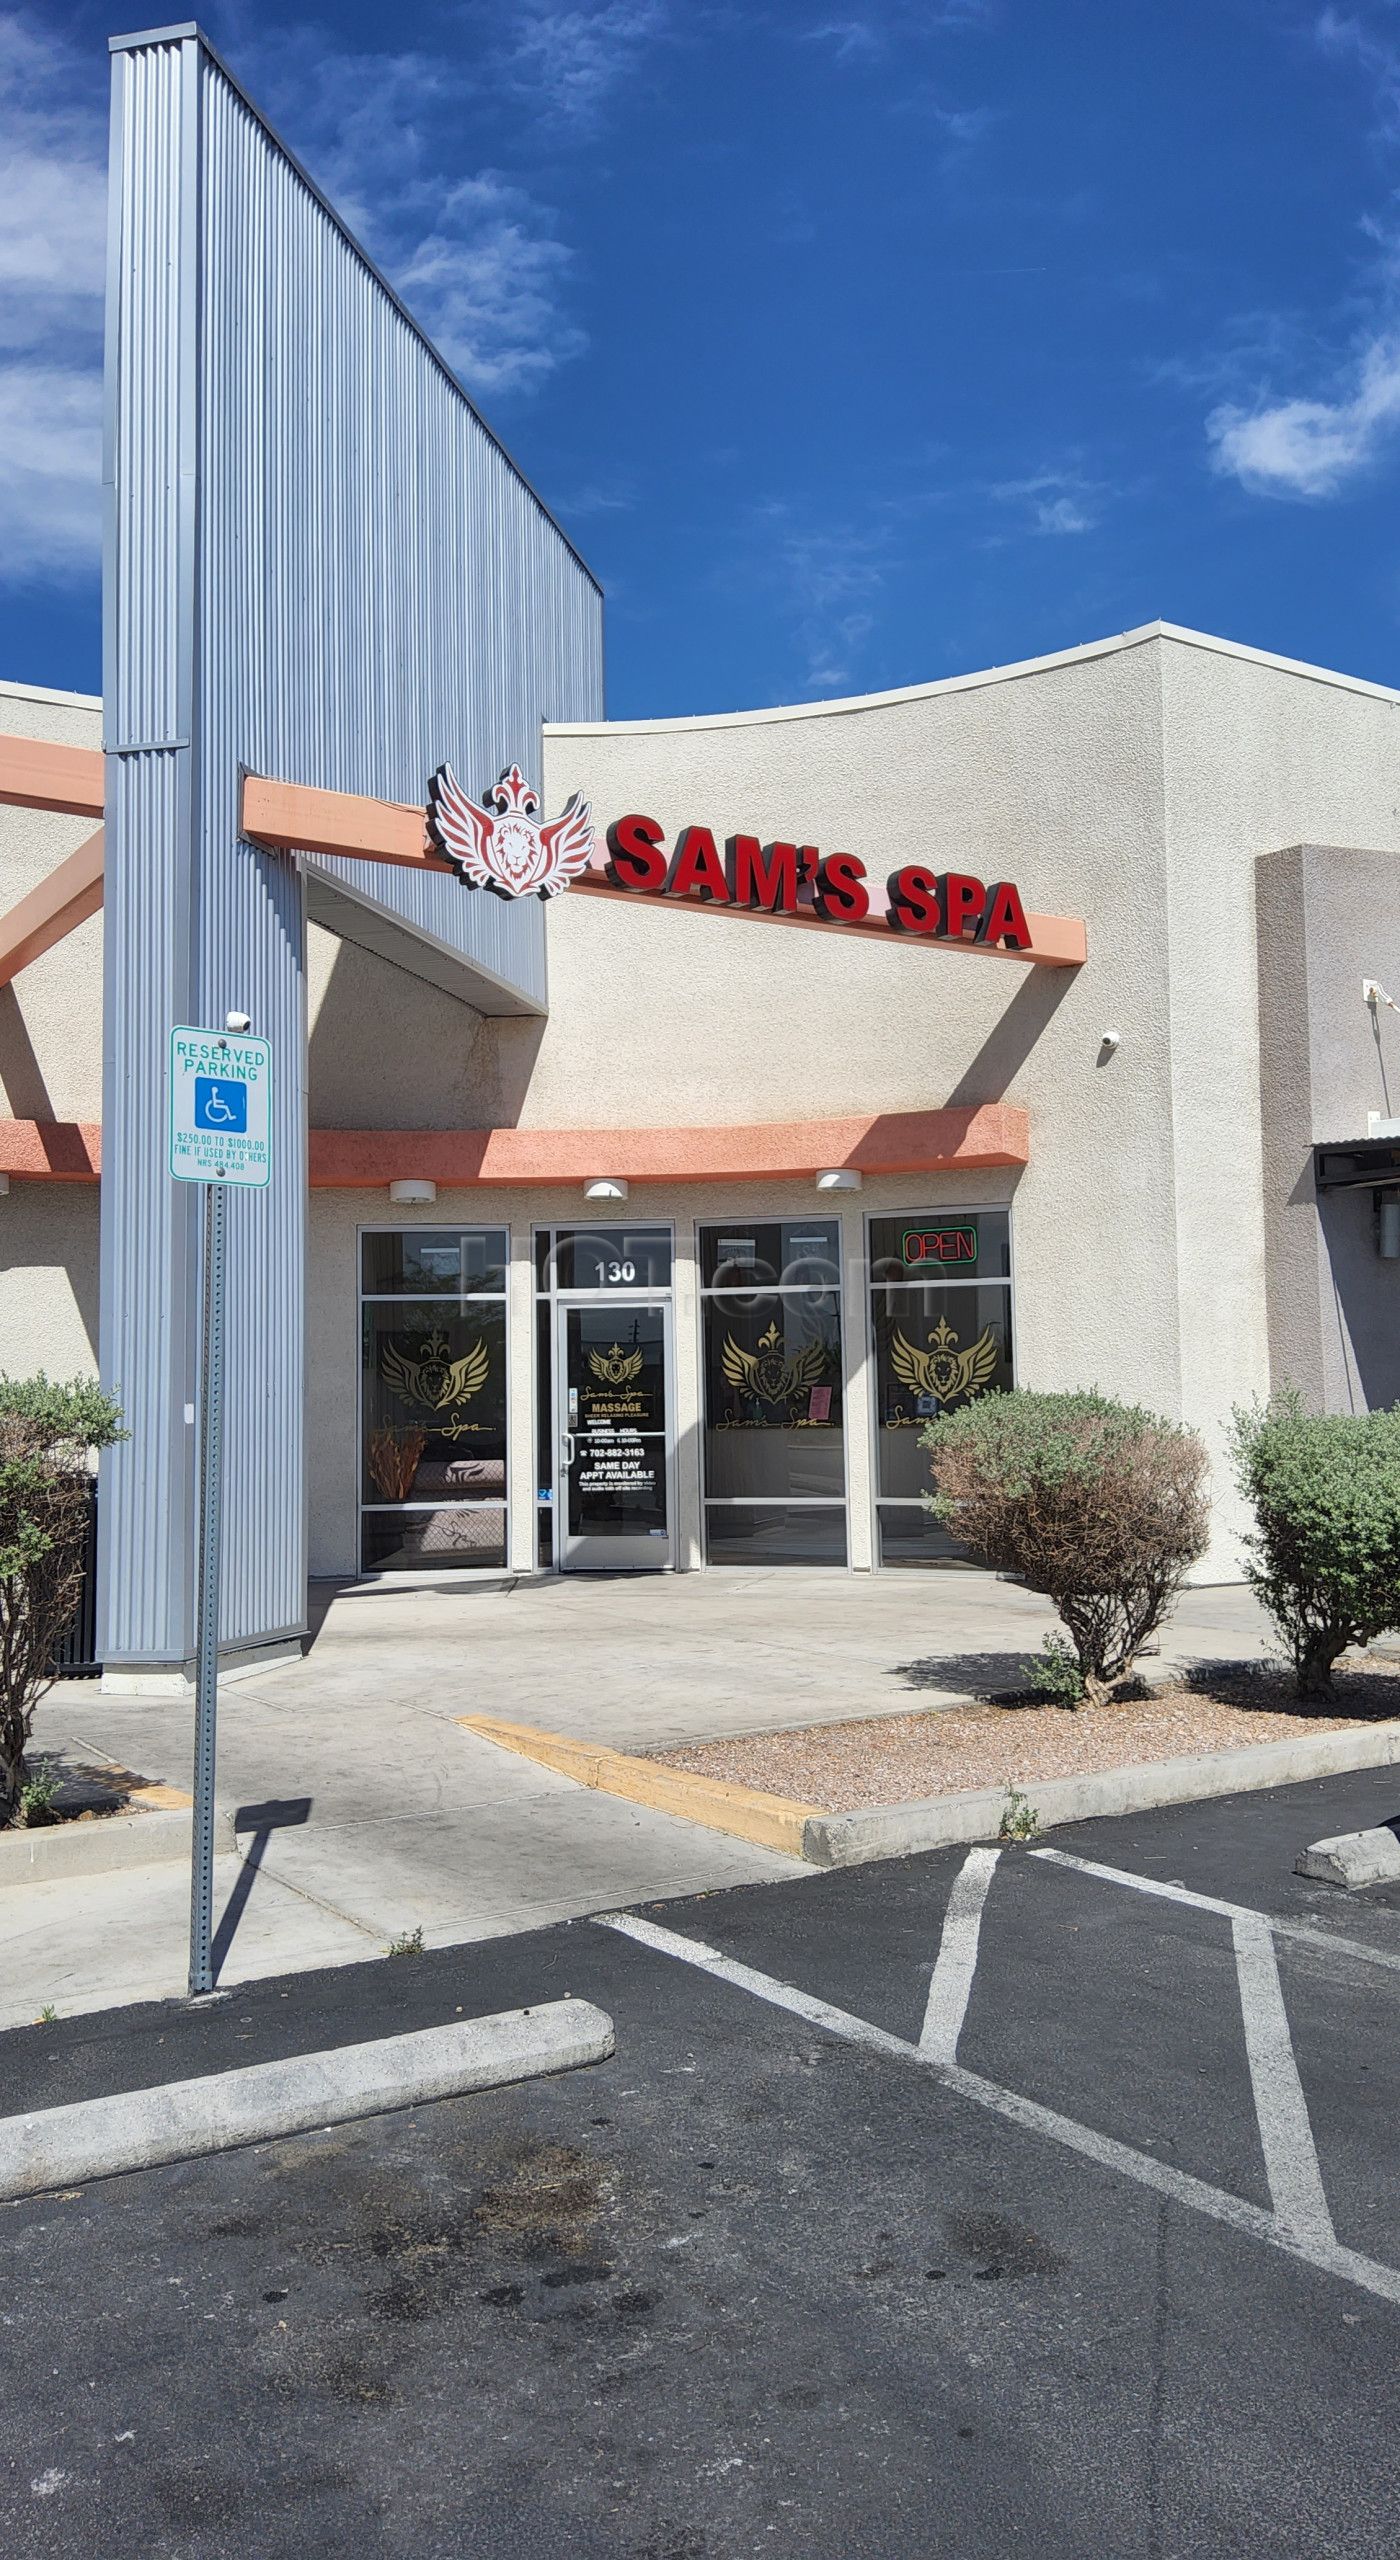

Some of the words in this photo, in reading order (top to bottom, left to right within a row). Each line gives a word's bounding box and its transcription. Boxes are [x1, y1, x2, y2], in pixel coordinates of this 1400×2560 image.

[606, 814, 869, 924] SAM'S
[887, 865, 1032, 949] SPA
[177, 1042, 265, 1067] RESERVED
[184, 1059, 258, 1081] PARKING
[177, 1132, 212, 1147] $250.00
[215, 1136, 224, 1147] TO
[227, 1138, 265, 1151] $1000.00
[174, 1144, 191, 1156] FINE
[194, 1146, 200, 1156] IF
[204, 1148, 224, 1159] USED
[226, 1150, 236, 1160] BY
[197, 1159, 213, 1168] NRS
[905, 1231, 974, 1262] OPEN
[595, 1261, 636, 1282] 130
[592, 1403, 641, 1412] MASSAGE
[441, 1412, 494, 1441] Spa
[589, 1448, 645, 1457] 702-882-3163
[580, 1471, 604, 1480] APPT
[605, 1470, 655, 1480] AVAILABLE
[594, 1461, 620, 1470] SAME
[622, 1461, 641, 1470] DAY
